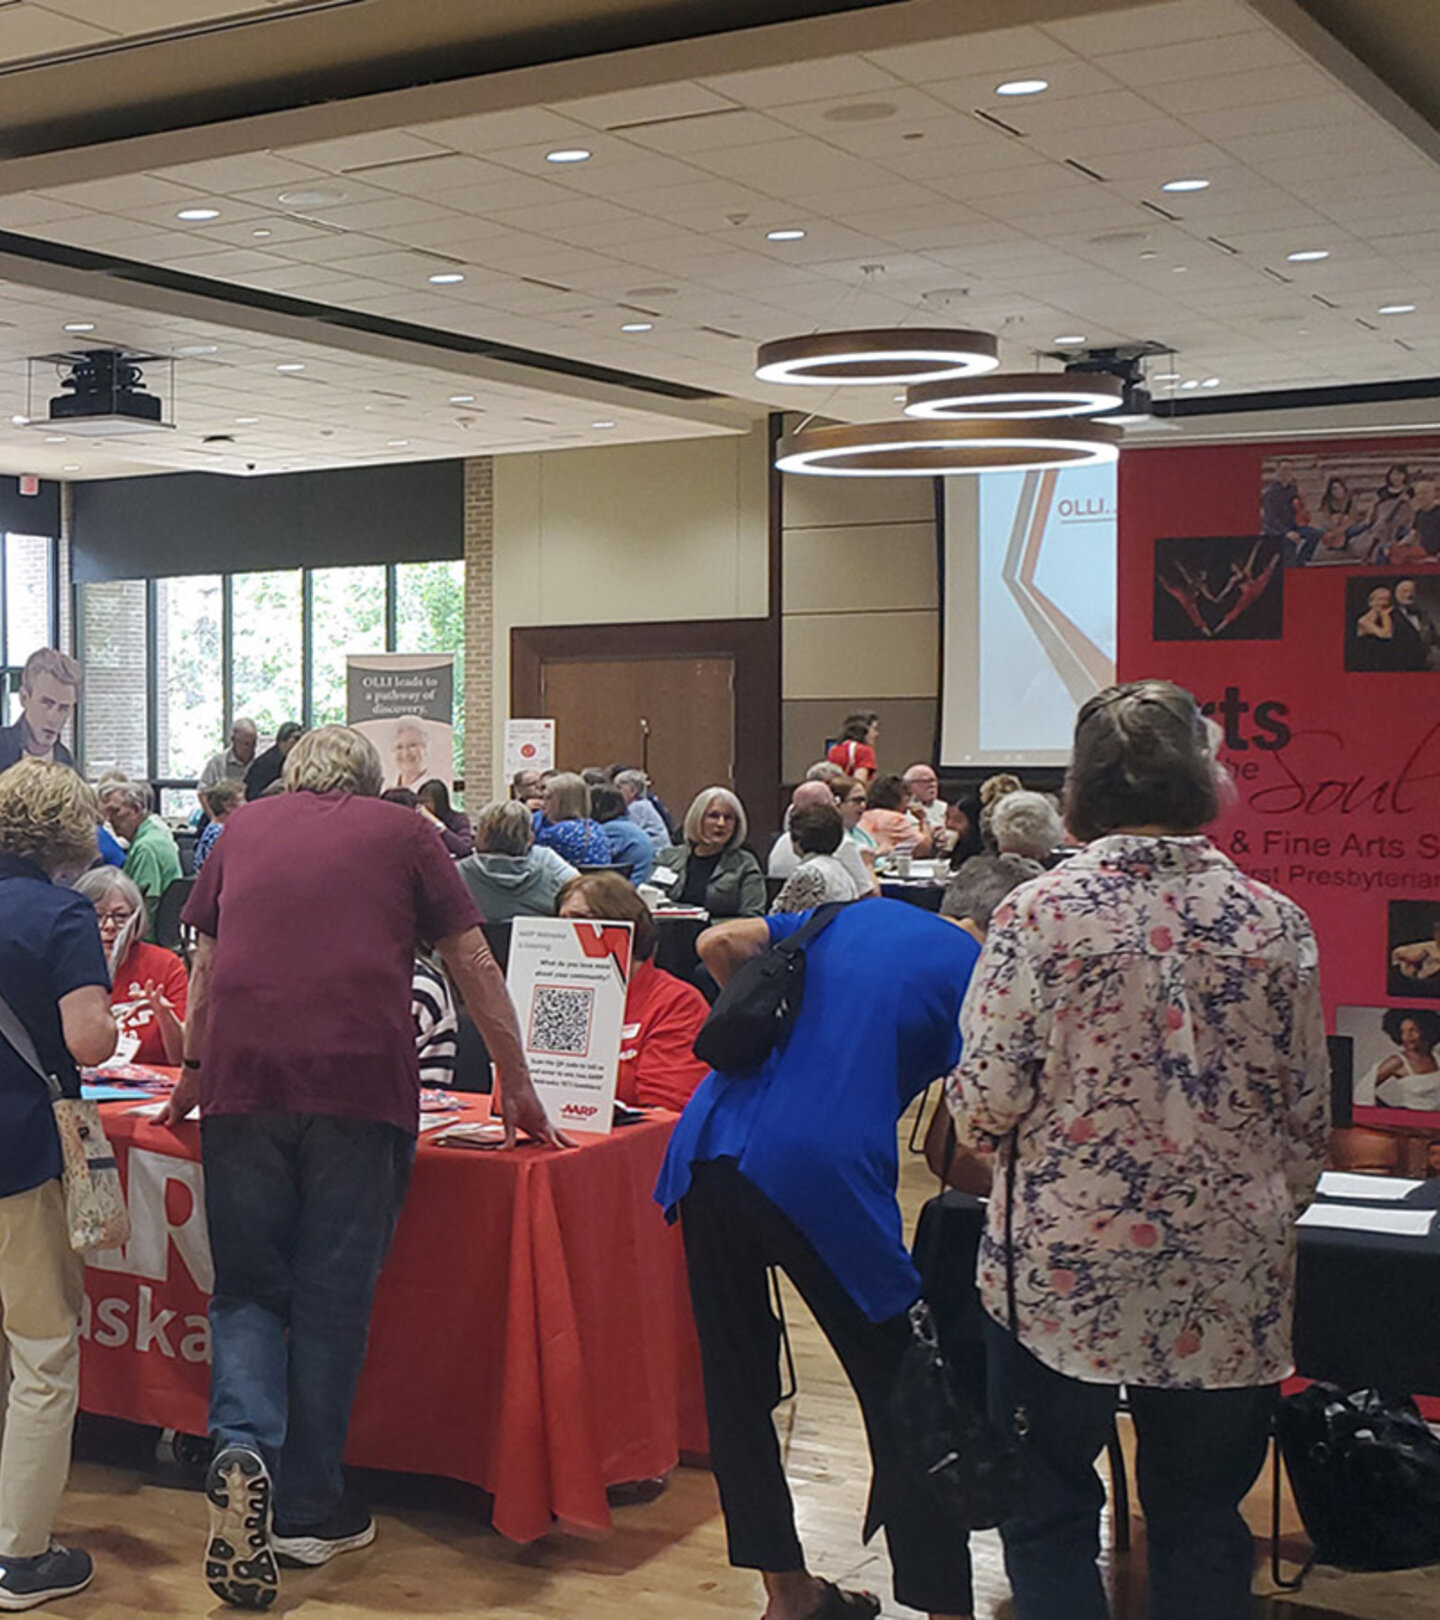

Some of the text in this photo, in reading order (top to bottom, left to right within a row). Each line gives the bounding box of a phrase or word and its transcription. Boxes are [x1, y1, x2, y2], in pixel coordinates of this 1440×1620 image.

[363, 676, 438, 688] OLLI leads to
[374, 689, 420, 704] pathway
[422, 688, 436, 701] of
[1264, 830, 1331, 857] Fine
[1340, 832, 1405, 858] Arts
[560, 1103, 599, 1117] AARP
